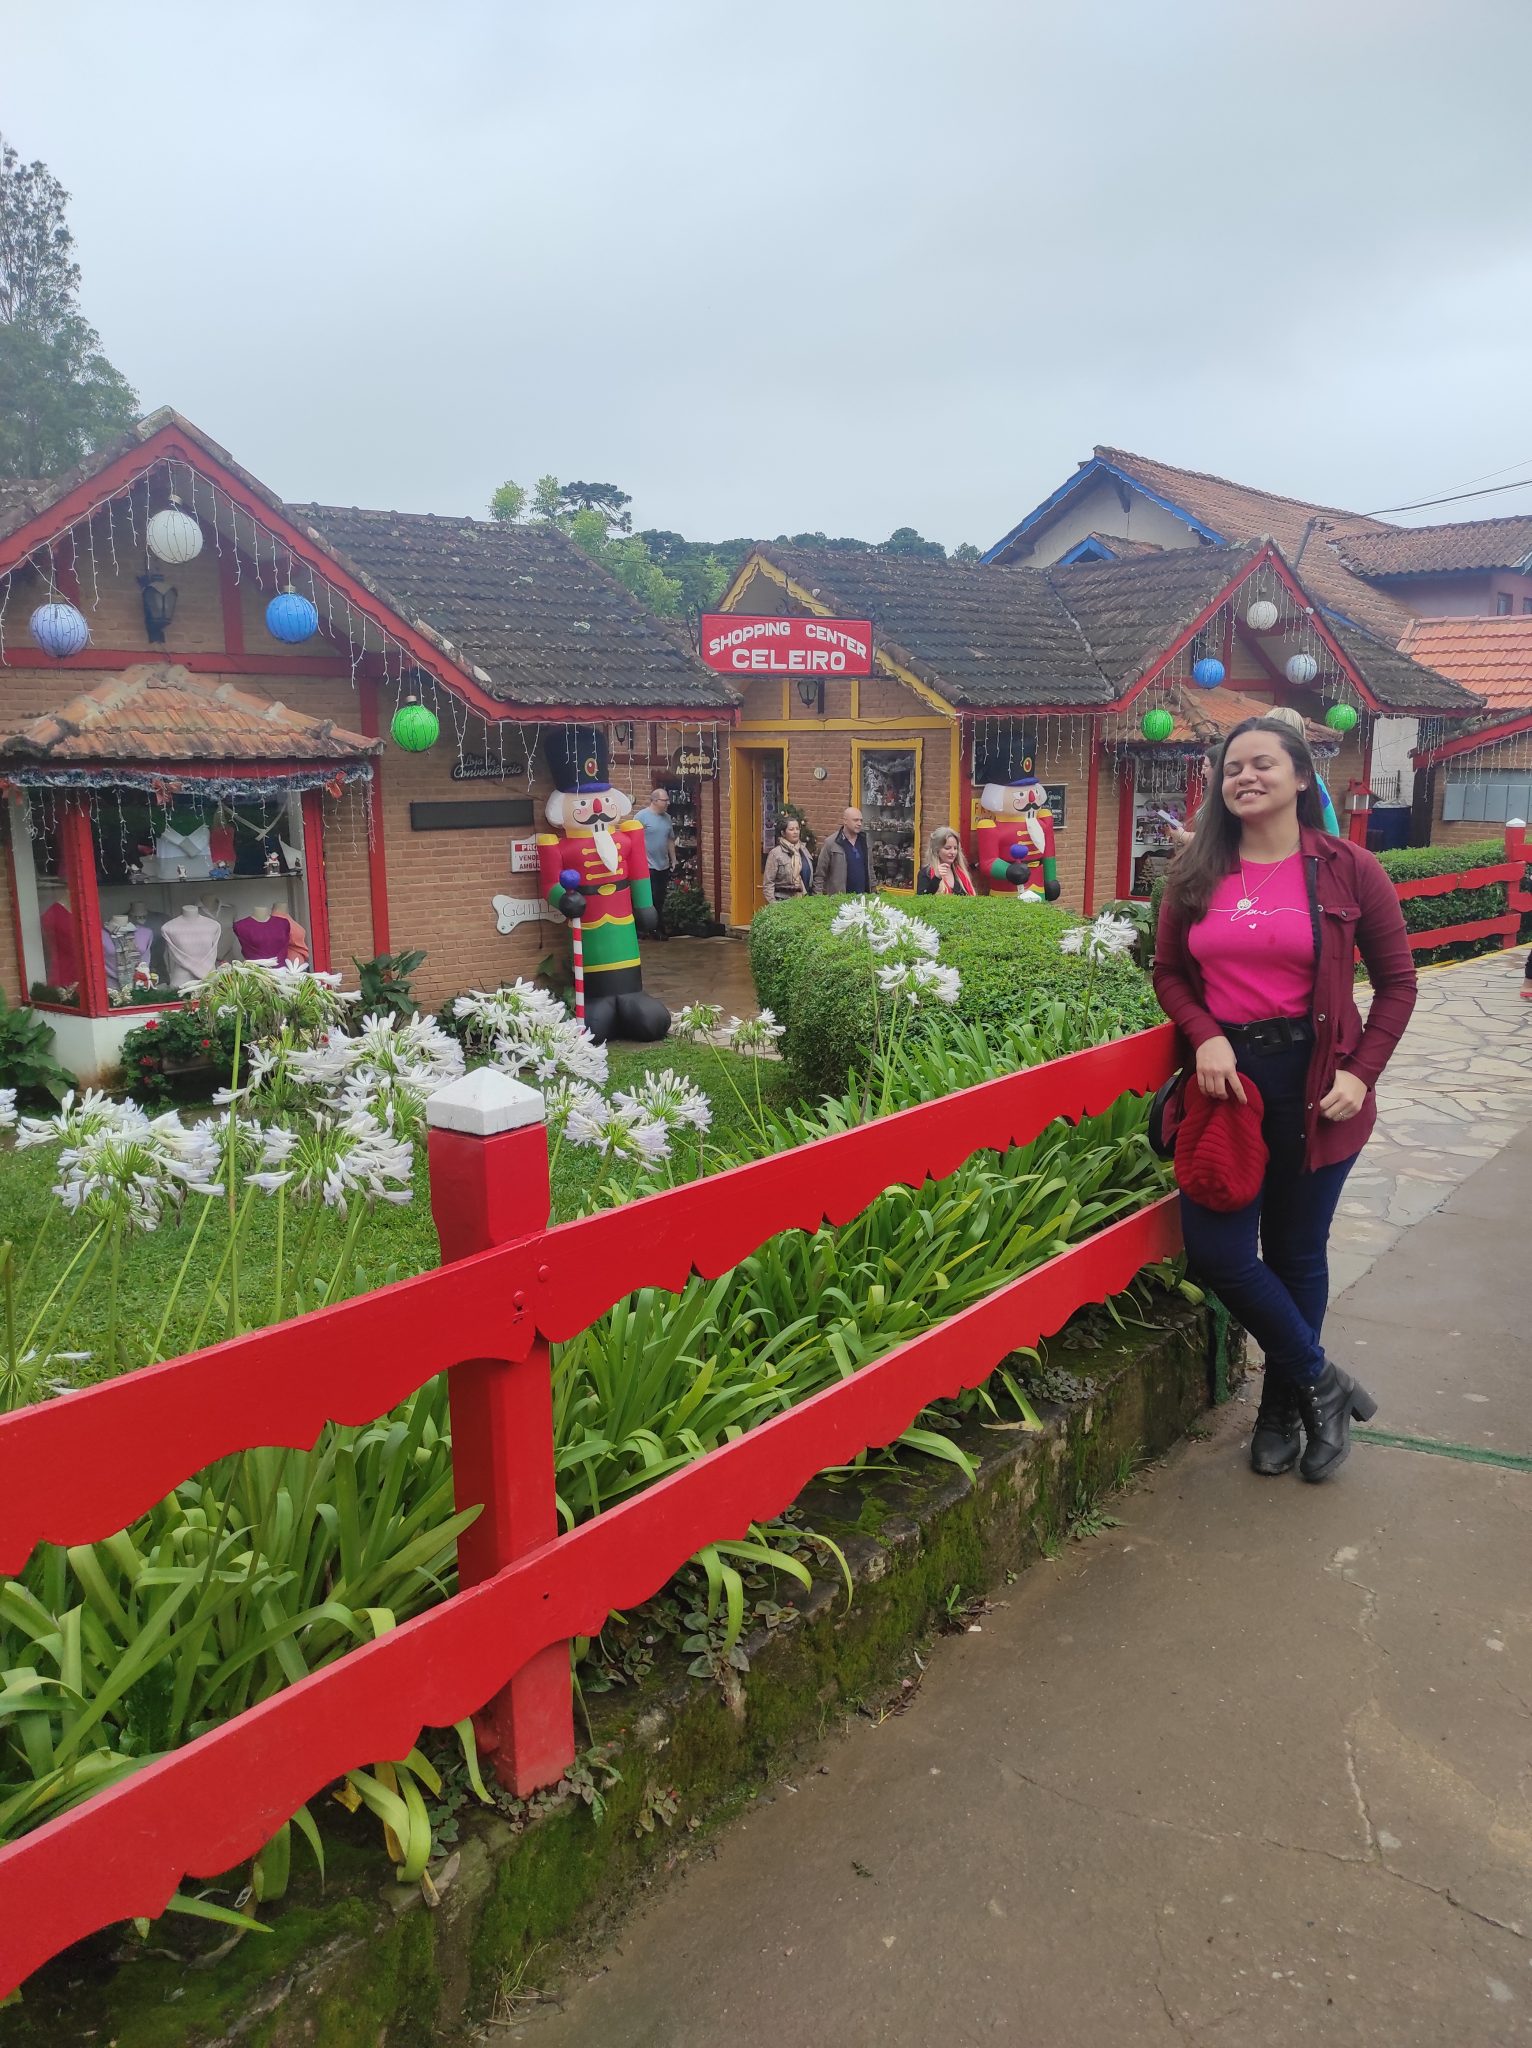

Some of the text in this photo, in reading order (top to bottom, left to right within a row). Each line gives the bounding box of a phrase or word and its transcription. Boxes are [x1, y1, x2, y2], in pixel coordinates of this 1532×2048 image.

[709, 621, 867, 659] SHOPPING CENTER
[732, 648, 845, 670] CELEIRO
